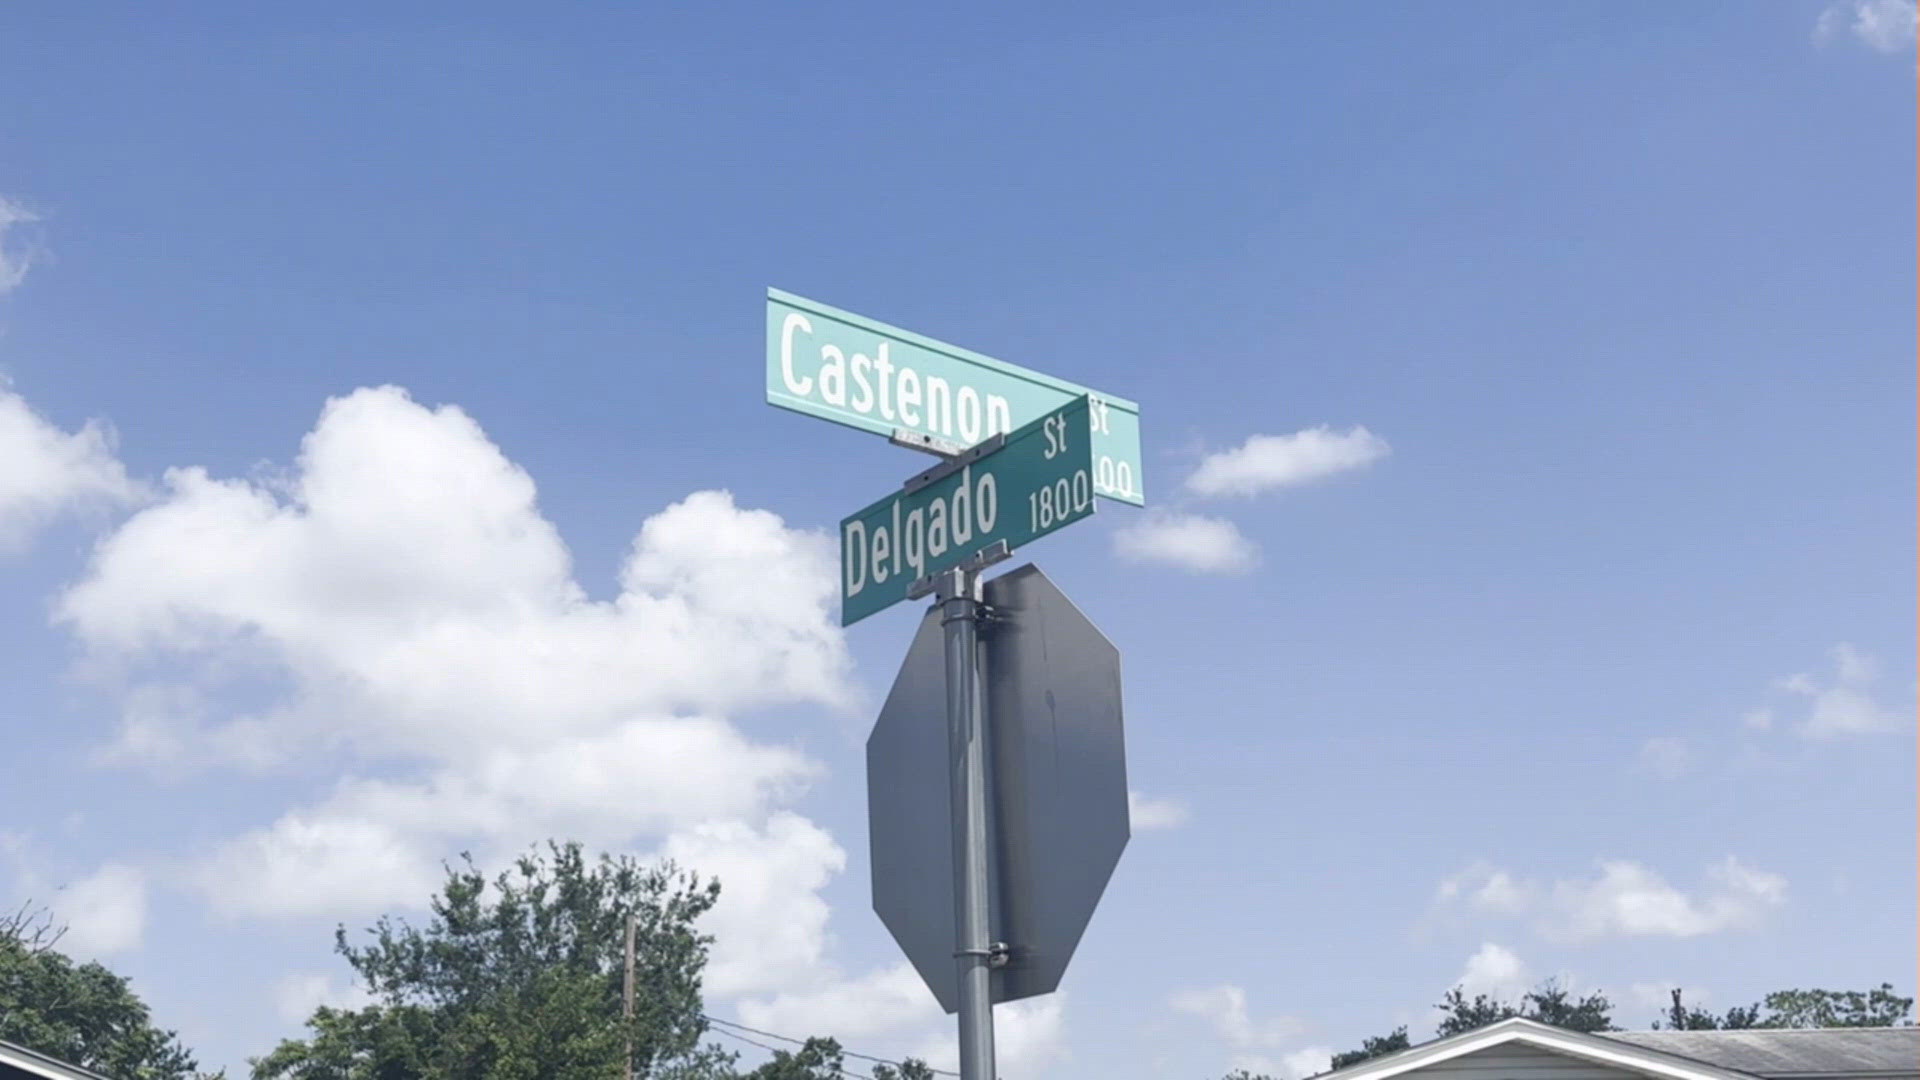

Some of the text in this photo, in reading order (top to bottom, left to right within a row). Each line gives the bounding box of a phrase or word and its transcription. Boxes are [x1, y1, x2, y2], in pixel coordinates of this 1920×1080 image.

[781, 312, 1010, 443] Castenon
[846, 412, 1067, 597] Delgado St
[1029, 470, 1088, 532] 1800
[1094, 456, 1132, 497] 00
